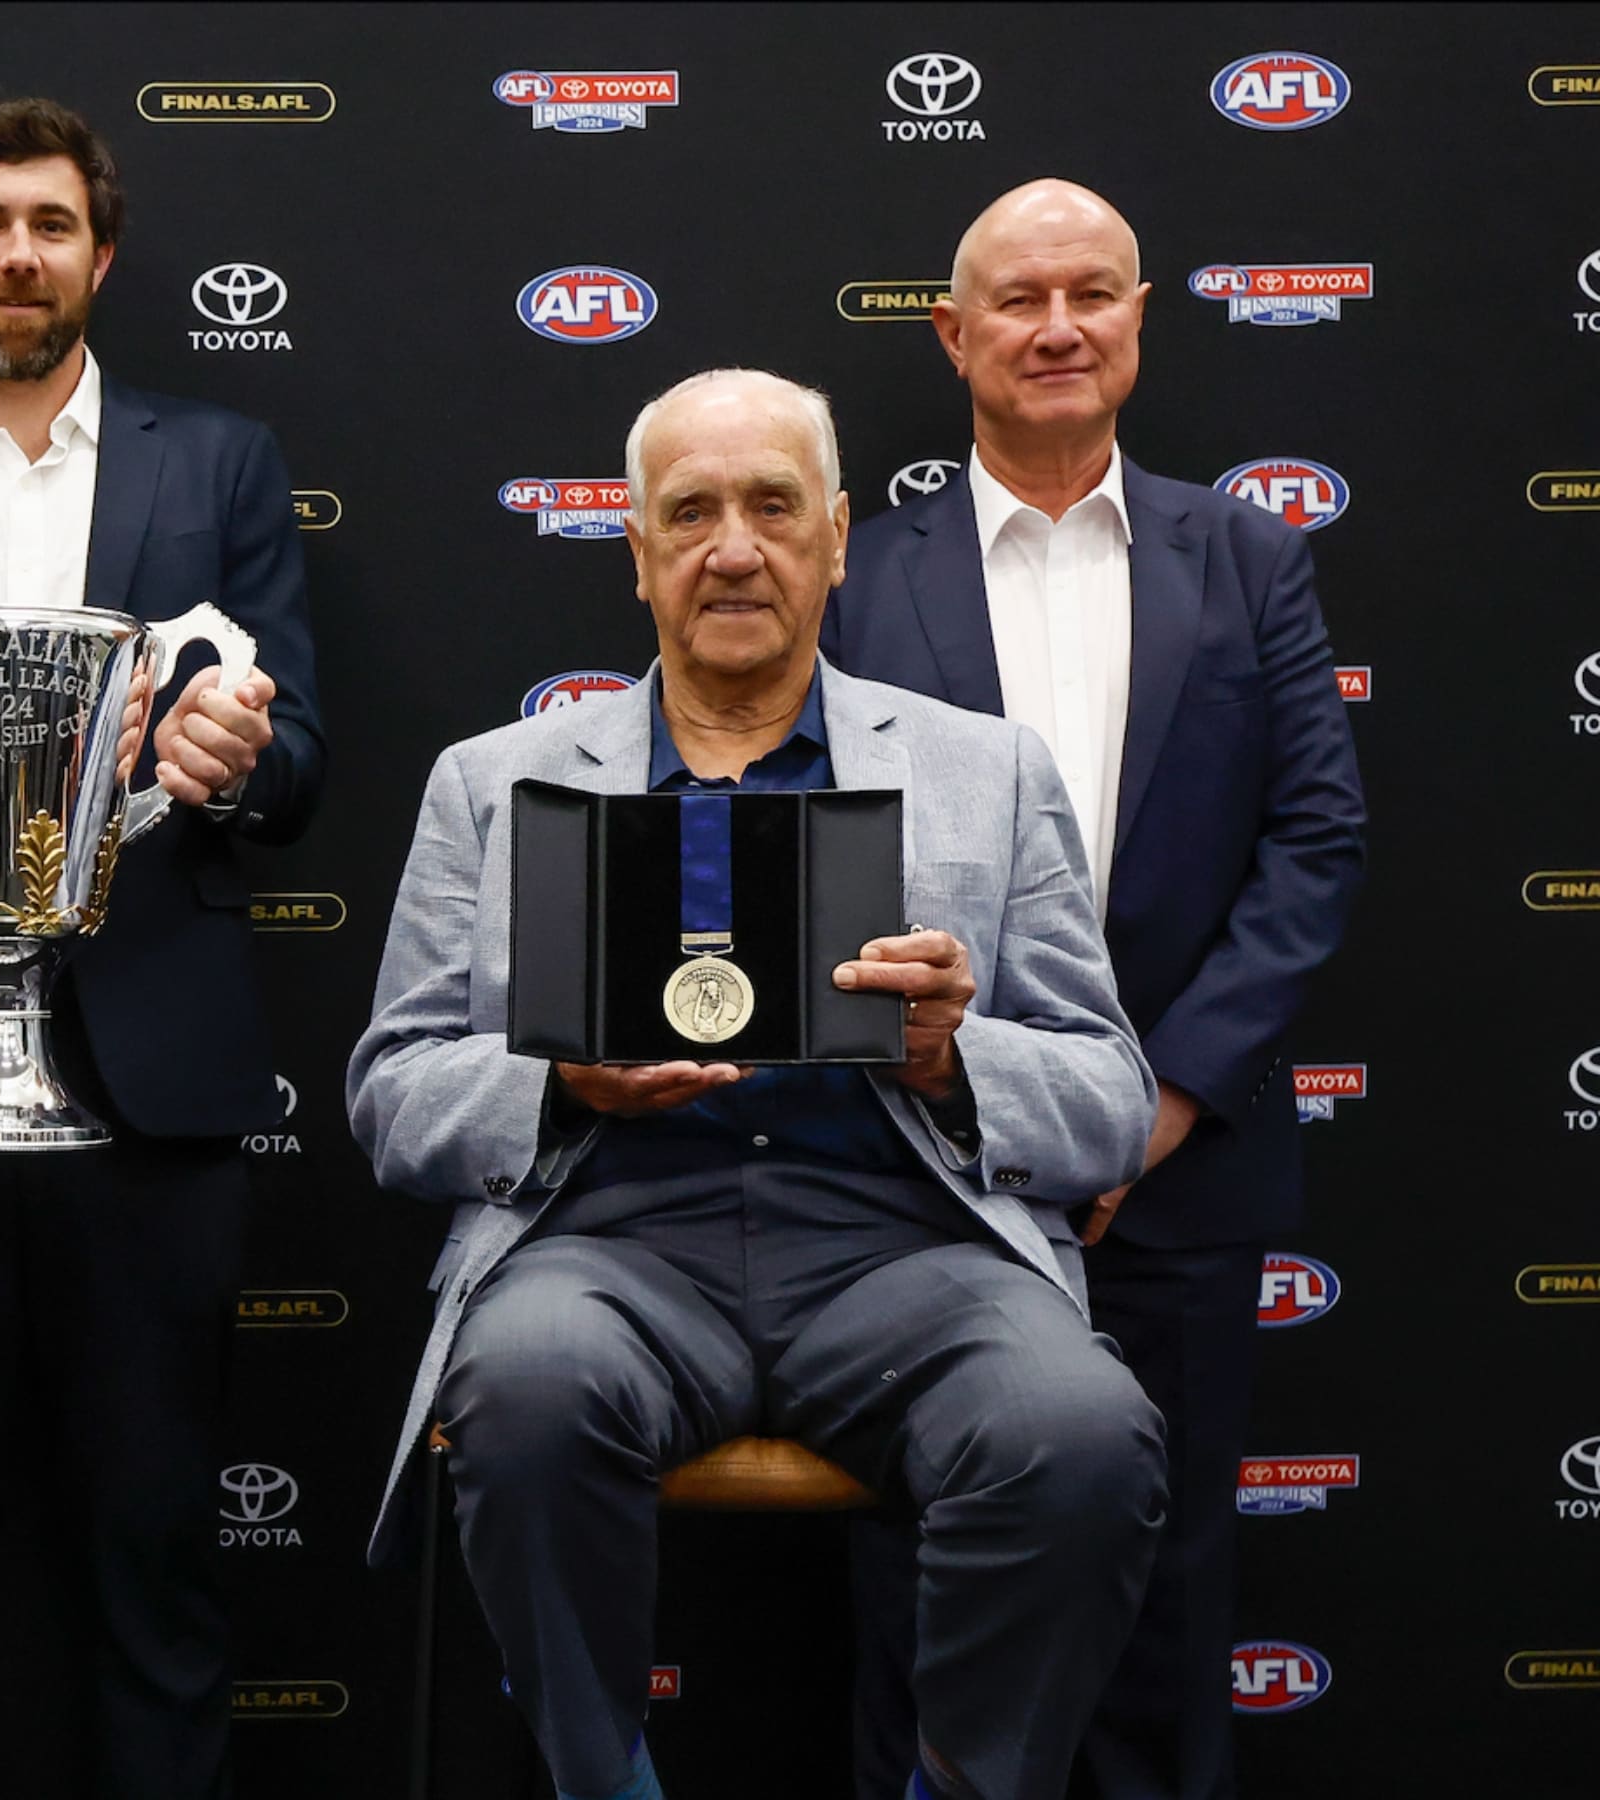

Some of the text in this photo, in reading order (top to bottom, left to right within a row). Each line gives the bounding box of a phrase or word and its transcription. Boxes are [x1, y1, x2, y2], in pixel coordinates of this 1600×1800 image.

[500, 79, 671, 97] AFL TOYOTA
[1225, 71, 1338, 110] AFL
[161, 95, 311, 110] FINALS.AFL
[882, 120, 986, 141] TOYOTA
[1195, 273, 1365, 292] AFL TOYOTA
[530, 285, 643, 323] AFL
[187, 330, 293, 352] TOYOTA
[505, 485, 555, 503] AFL
[56, 710, 90, 738] CUP
[250, 905, 322, 920] S.AFL
[1295, 1074, 1359, 1090] OYOTA
[1258, 1271, 1327, 1308] FL
[237, 1302, 324, 1317] LS.AFL
[1278, 1464, 1352, 1480] TOYOTA
[220, 1528, 302, 1546] OYOTA
